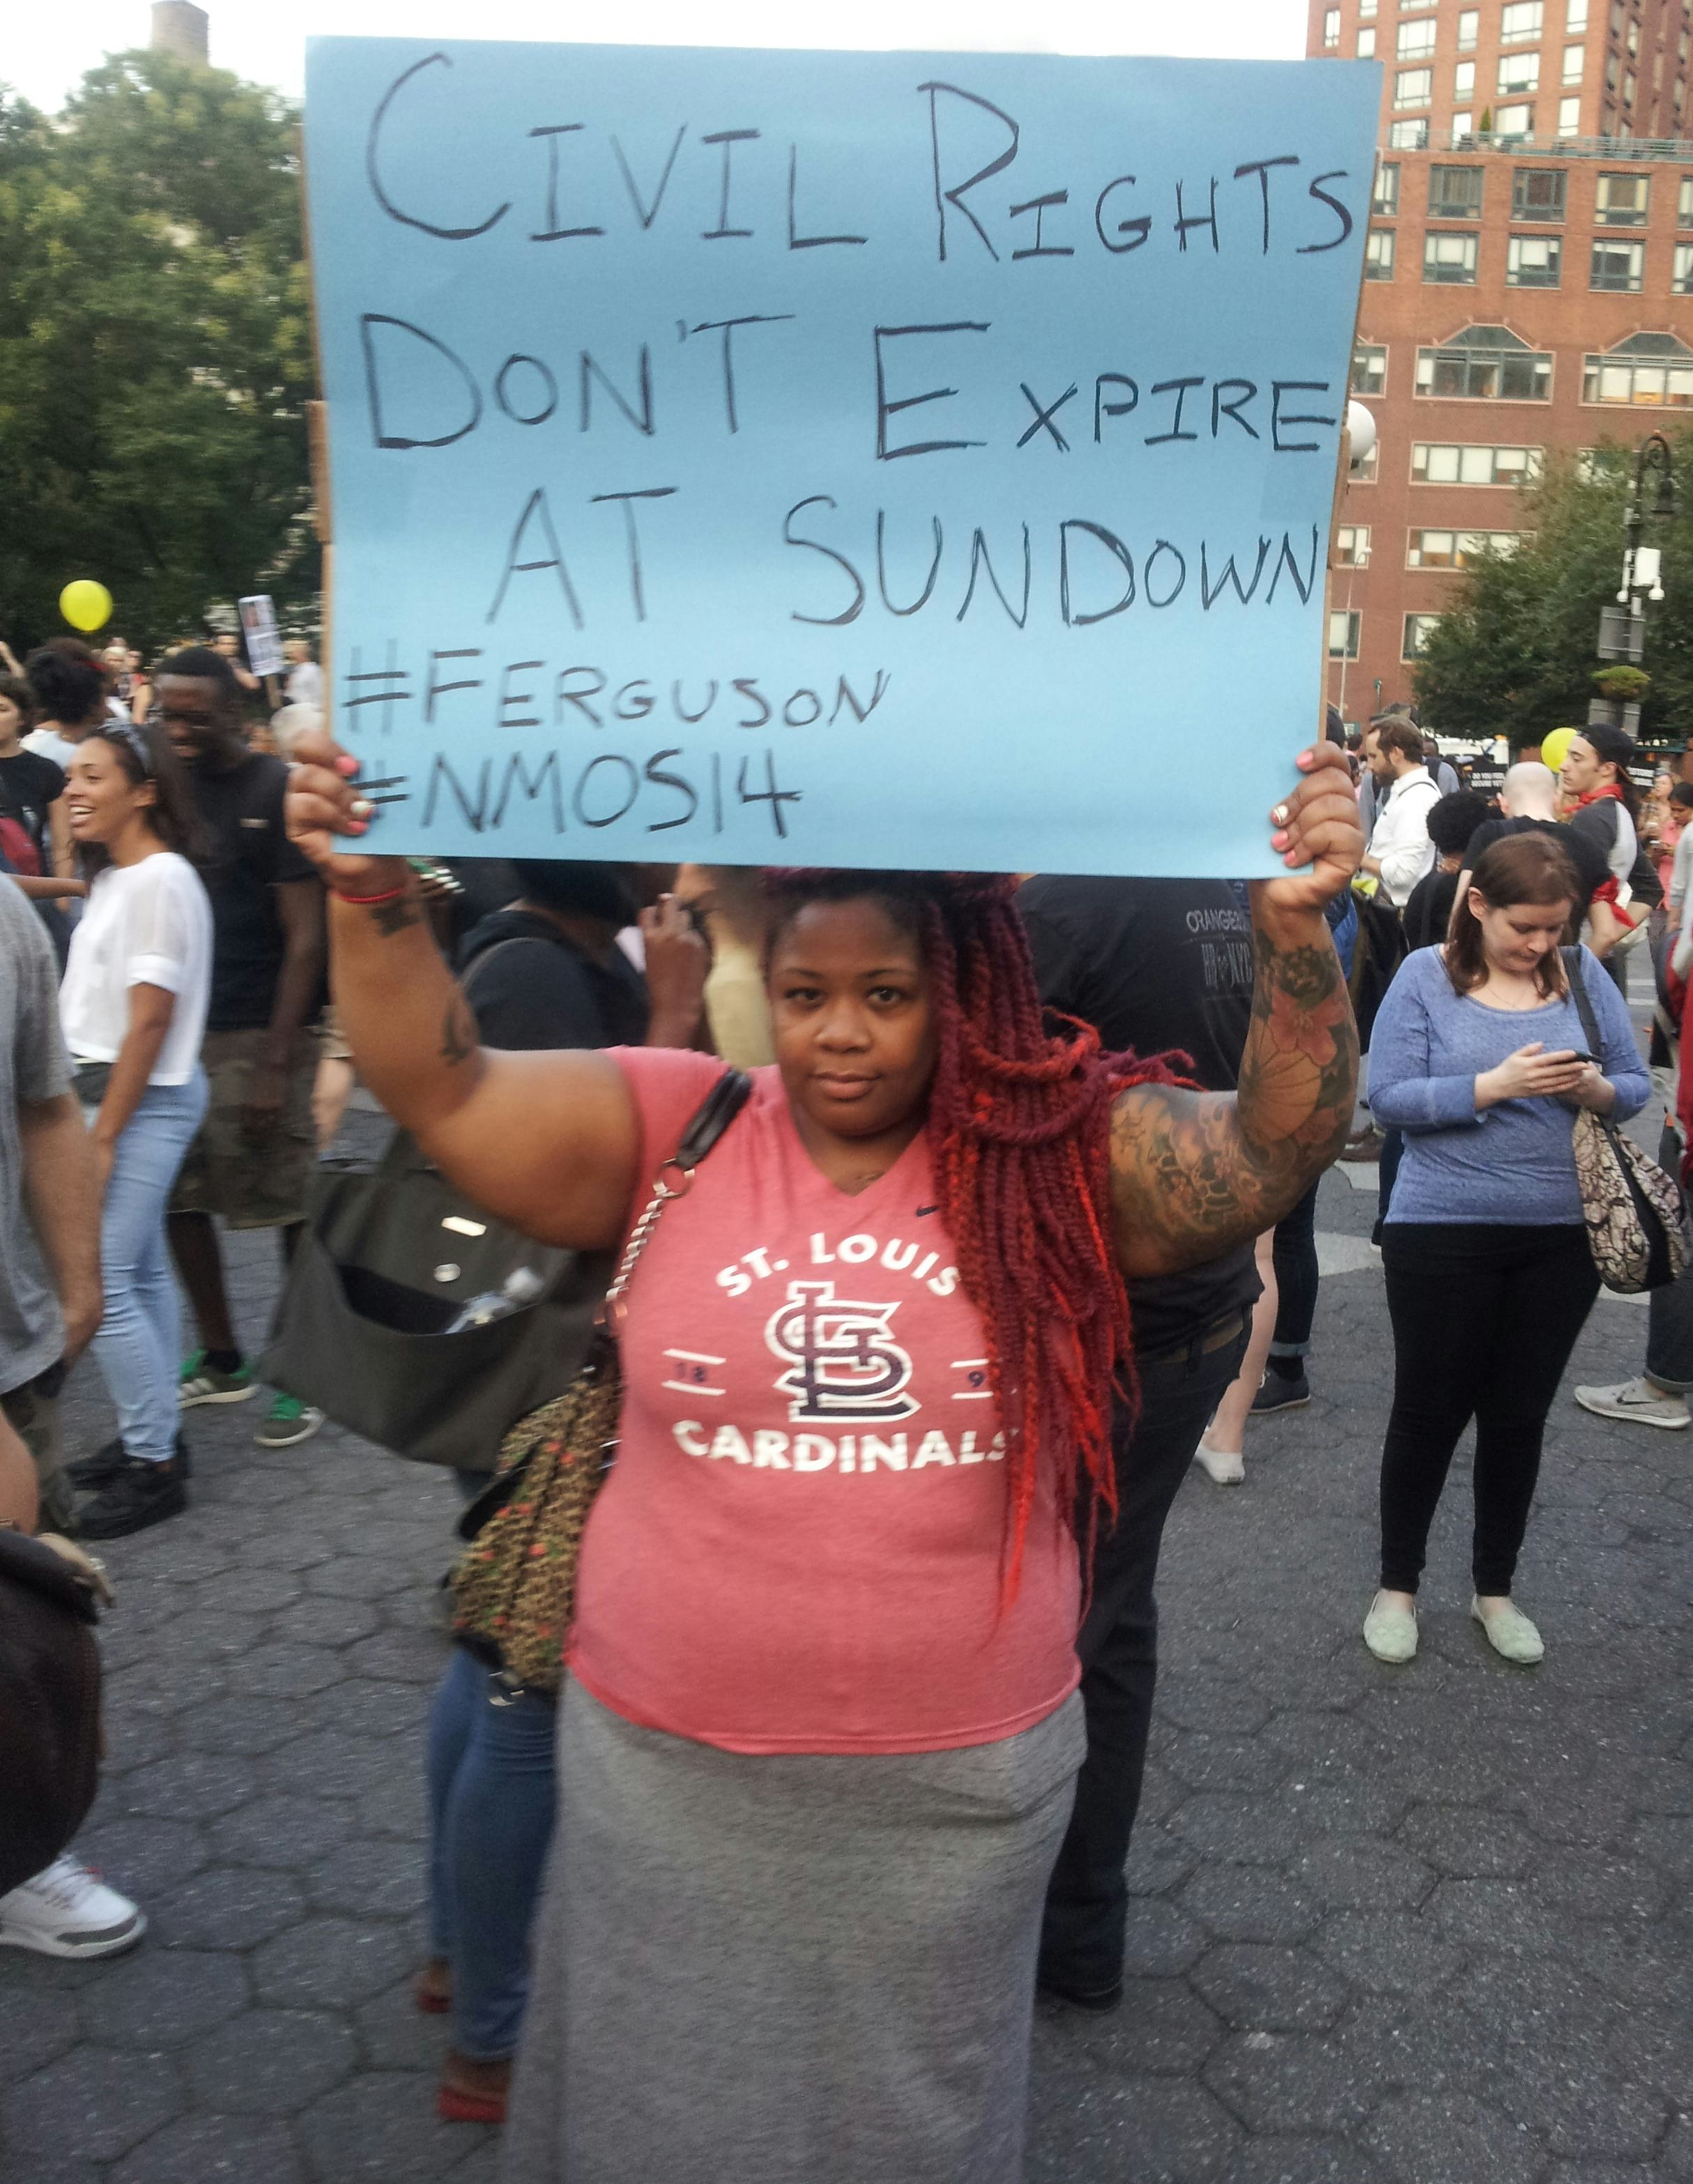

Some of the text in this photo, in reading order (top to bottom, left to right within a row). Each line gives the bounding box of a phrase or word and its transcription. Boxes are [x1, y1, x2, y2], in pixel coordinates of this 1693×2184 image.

[366, 52, 1353, 261] CIVIL RIGHTS
[360, 313, 1336, 461] DON'T EXPIRE
[486, 487, 1318, 630] AT SUNDOWN
[341, 639, 891, 735] #FERGUSON
[350, 747, 803, 839] #NMOS14
[716, 1232, 962, 1297] ST. LOUIS
